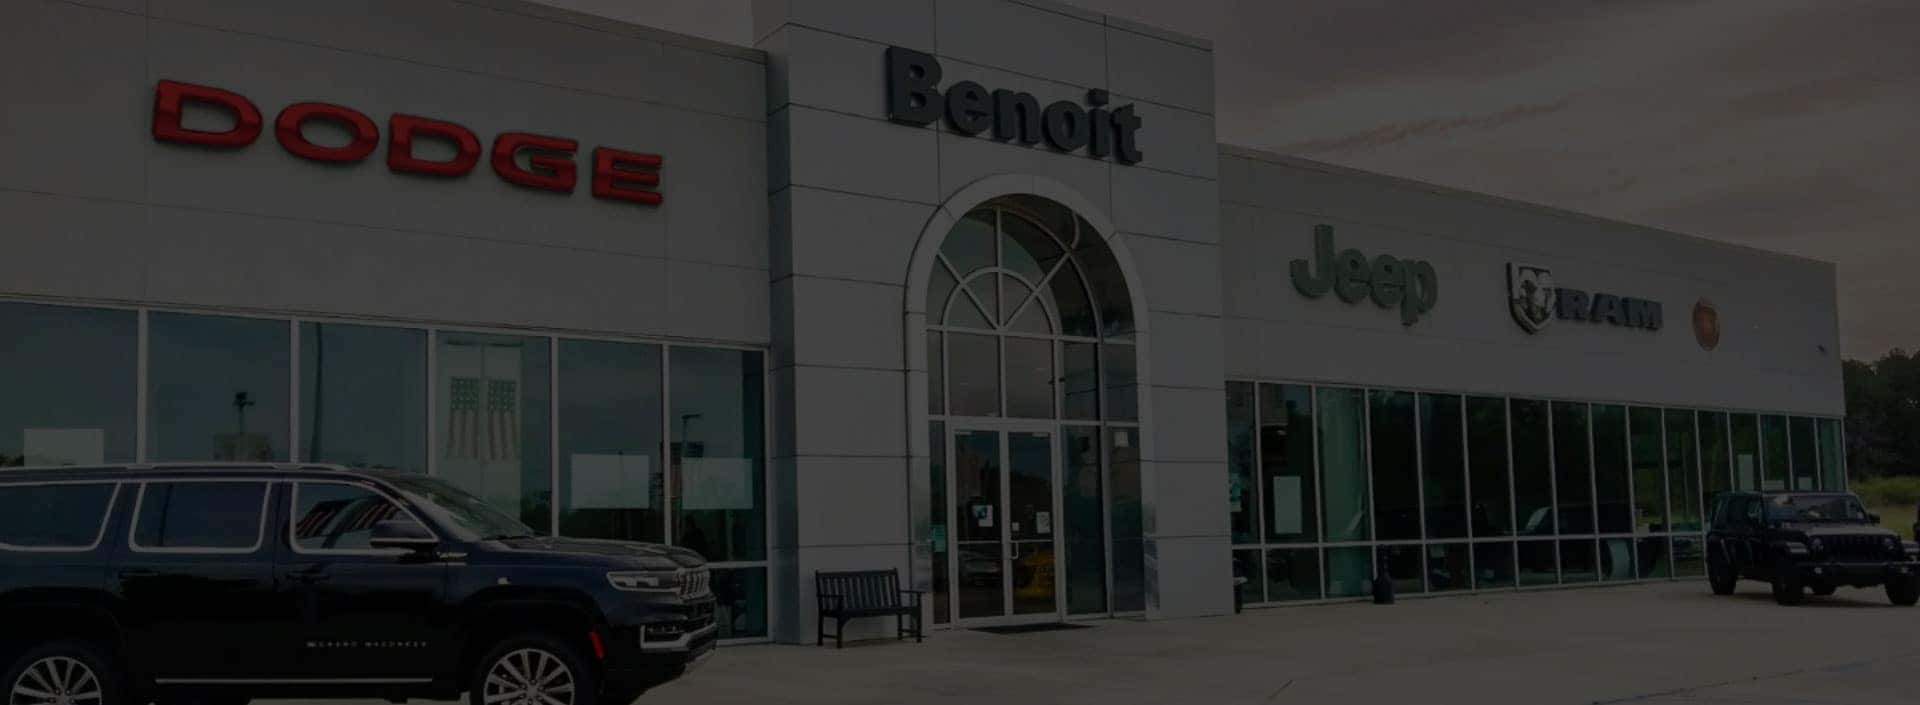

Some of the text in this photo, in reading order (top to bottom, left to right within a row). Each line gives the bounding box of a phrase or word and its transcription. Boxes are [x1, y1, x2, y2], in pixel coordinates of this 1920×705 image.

[153, 79, 663, 205] DODGE
[885, 46, 1142, 165] Benoit
[1289, 224, 1437, 325] Jeep
[1553, 287, 1663, 330] RAM
